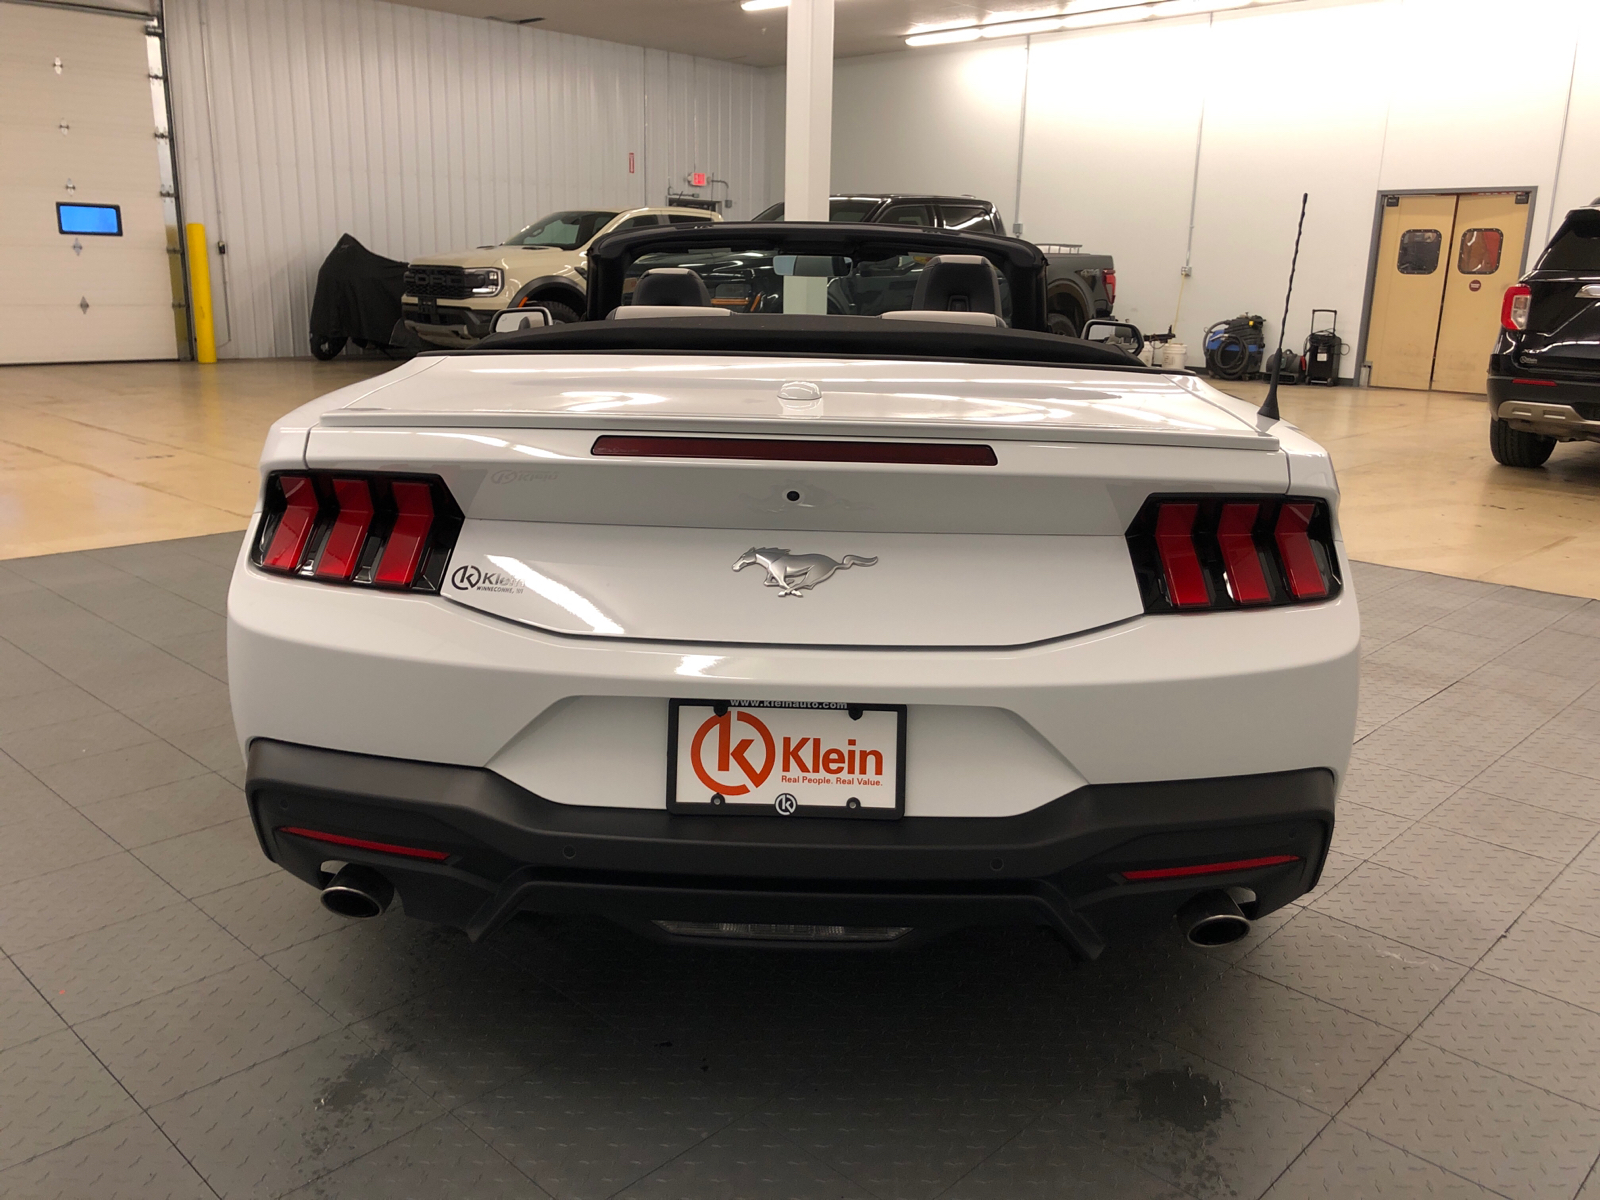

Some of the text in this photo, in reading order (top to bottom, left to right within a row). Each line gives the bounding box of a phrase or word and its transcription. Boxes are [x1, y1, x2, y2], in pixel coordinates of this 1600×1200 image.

[730, 698, 848, 709] www.kleinauto.com
[781, 736, 883, 776] Klein
[781, 775, 883, 786] Real People. Real Value.
